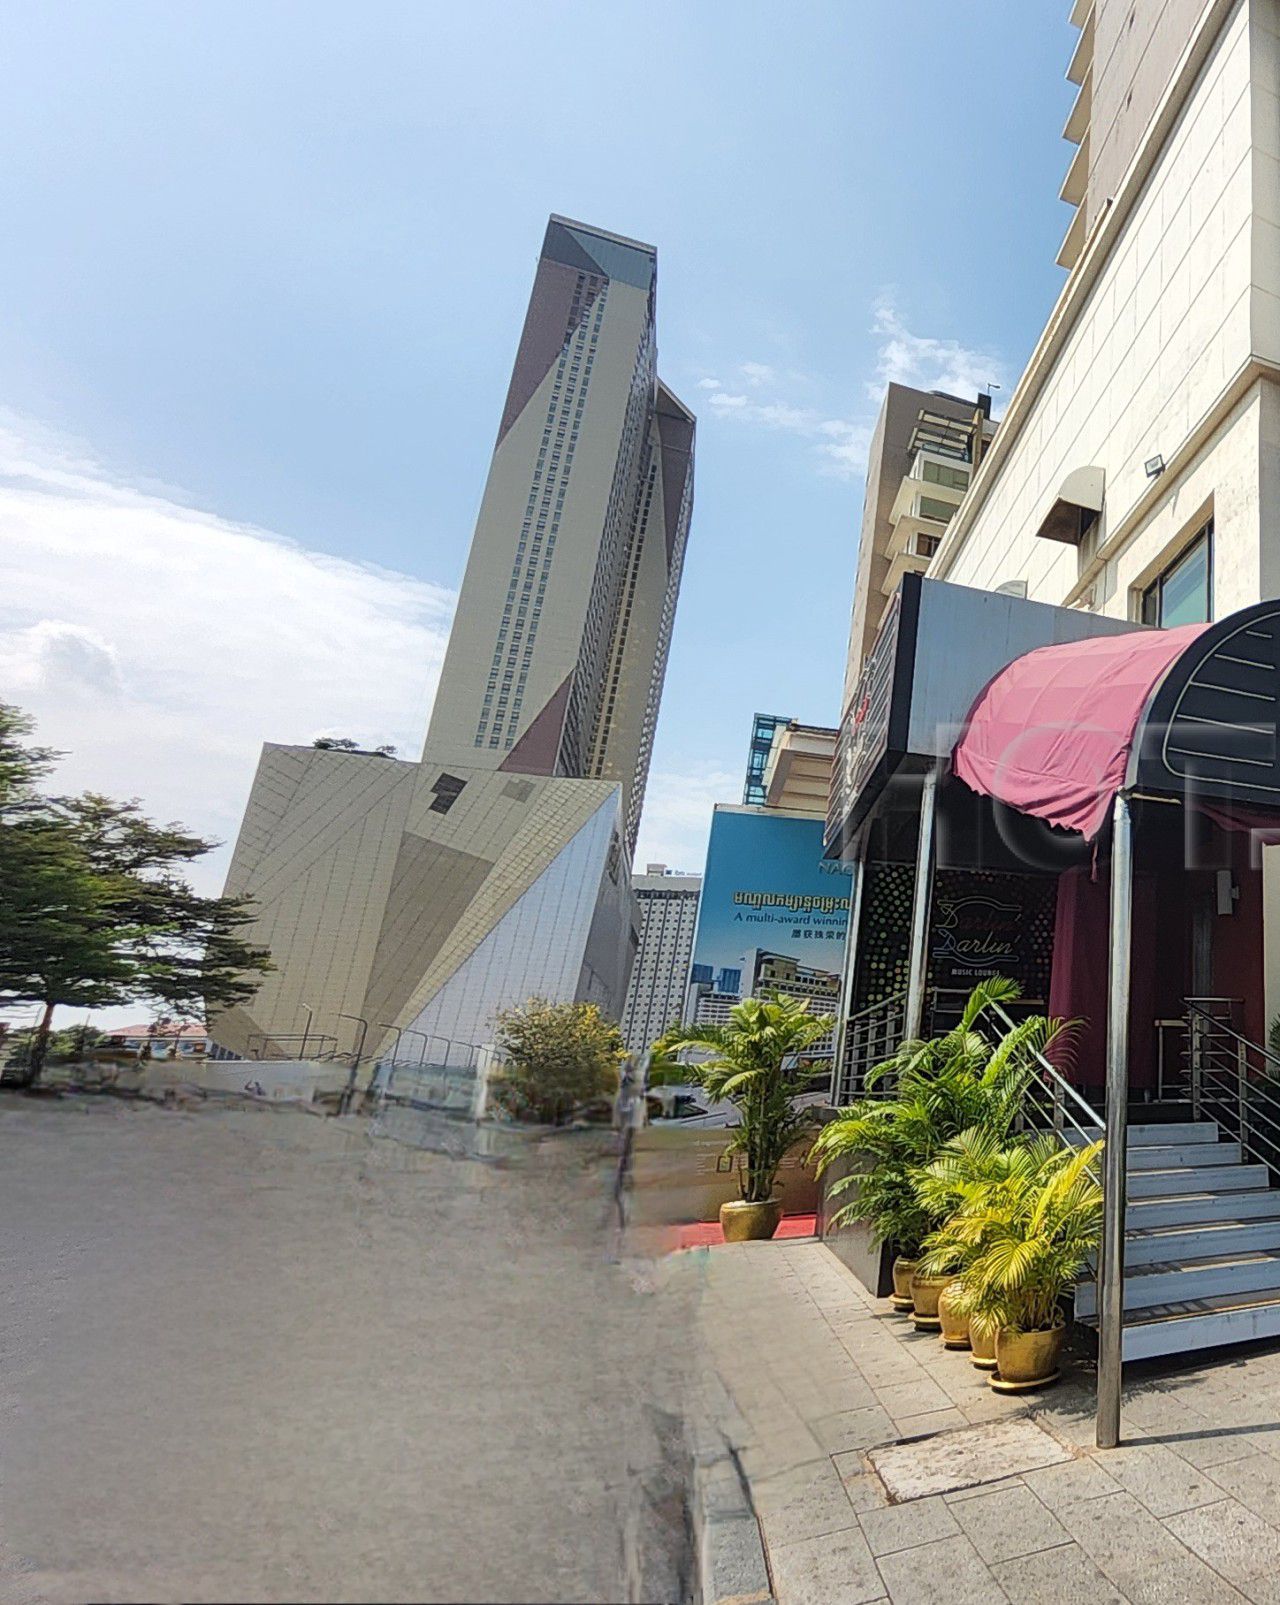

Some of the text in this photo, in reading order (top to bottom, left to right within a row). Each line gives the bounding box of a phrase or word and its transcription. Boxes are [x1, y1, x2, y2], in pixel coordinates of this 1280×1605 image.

[734, 912, 848, 926] A multi-award winnin
[951, 968, 973, 976] MUSIC
